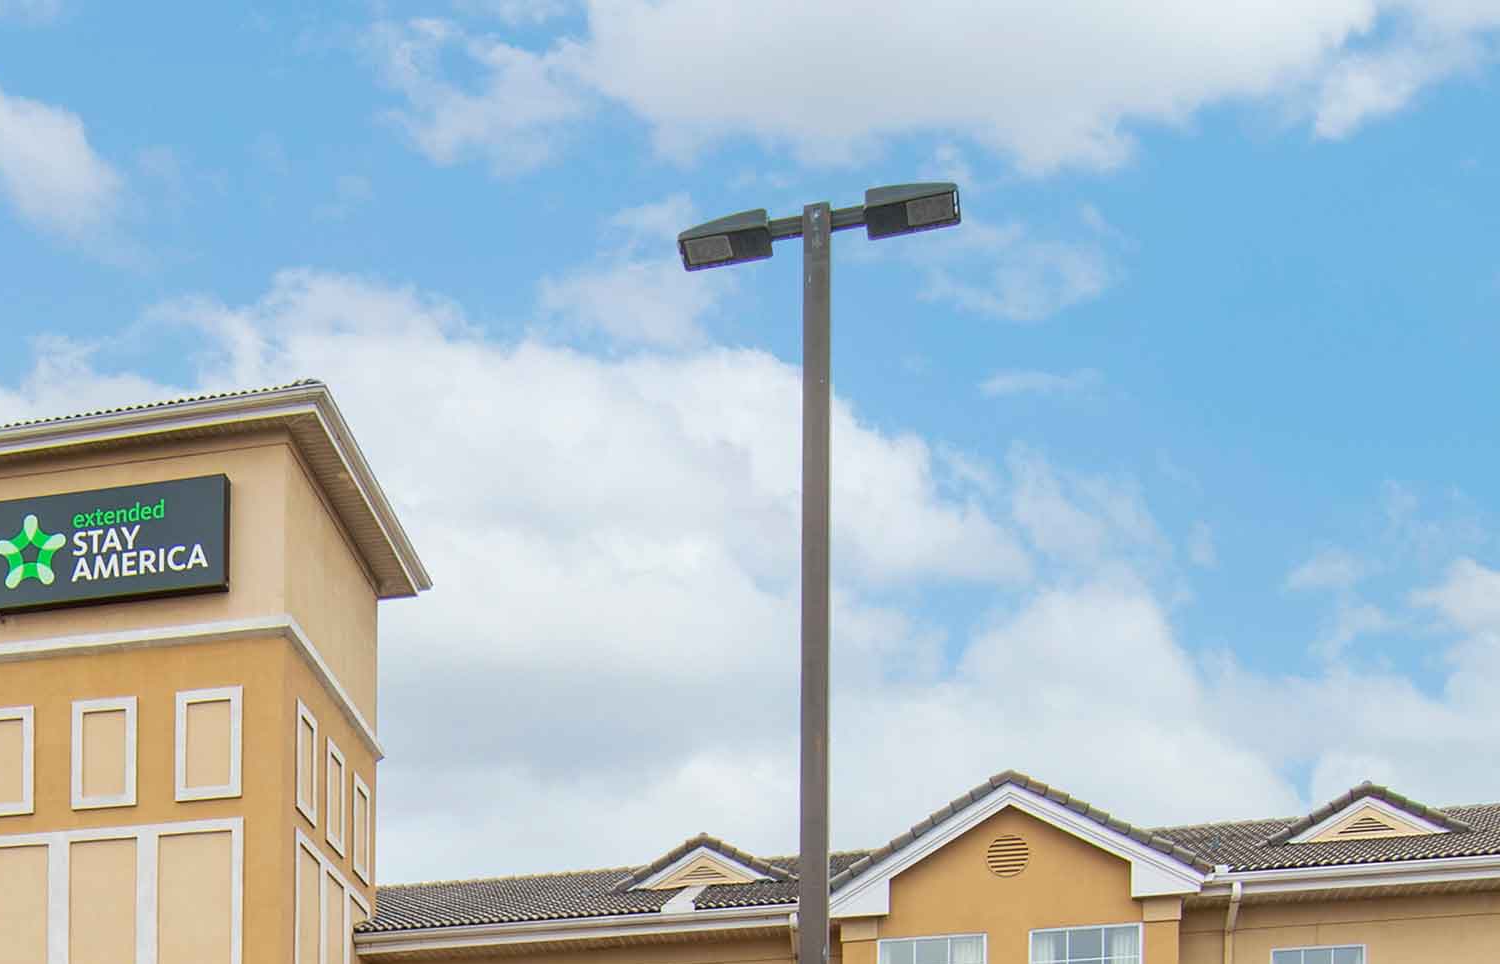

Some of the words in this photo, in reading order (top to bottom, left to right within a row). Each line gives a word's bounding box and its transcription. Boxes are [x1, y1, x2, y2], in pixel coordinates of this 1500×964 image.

[73, 499, 165, 528] extended
[72, 525, 141, 556] STAY
[71, 543, 209, 582] AMERICA
